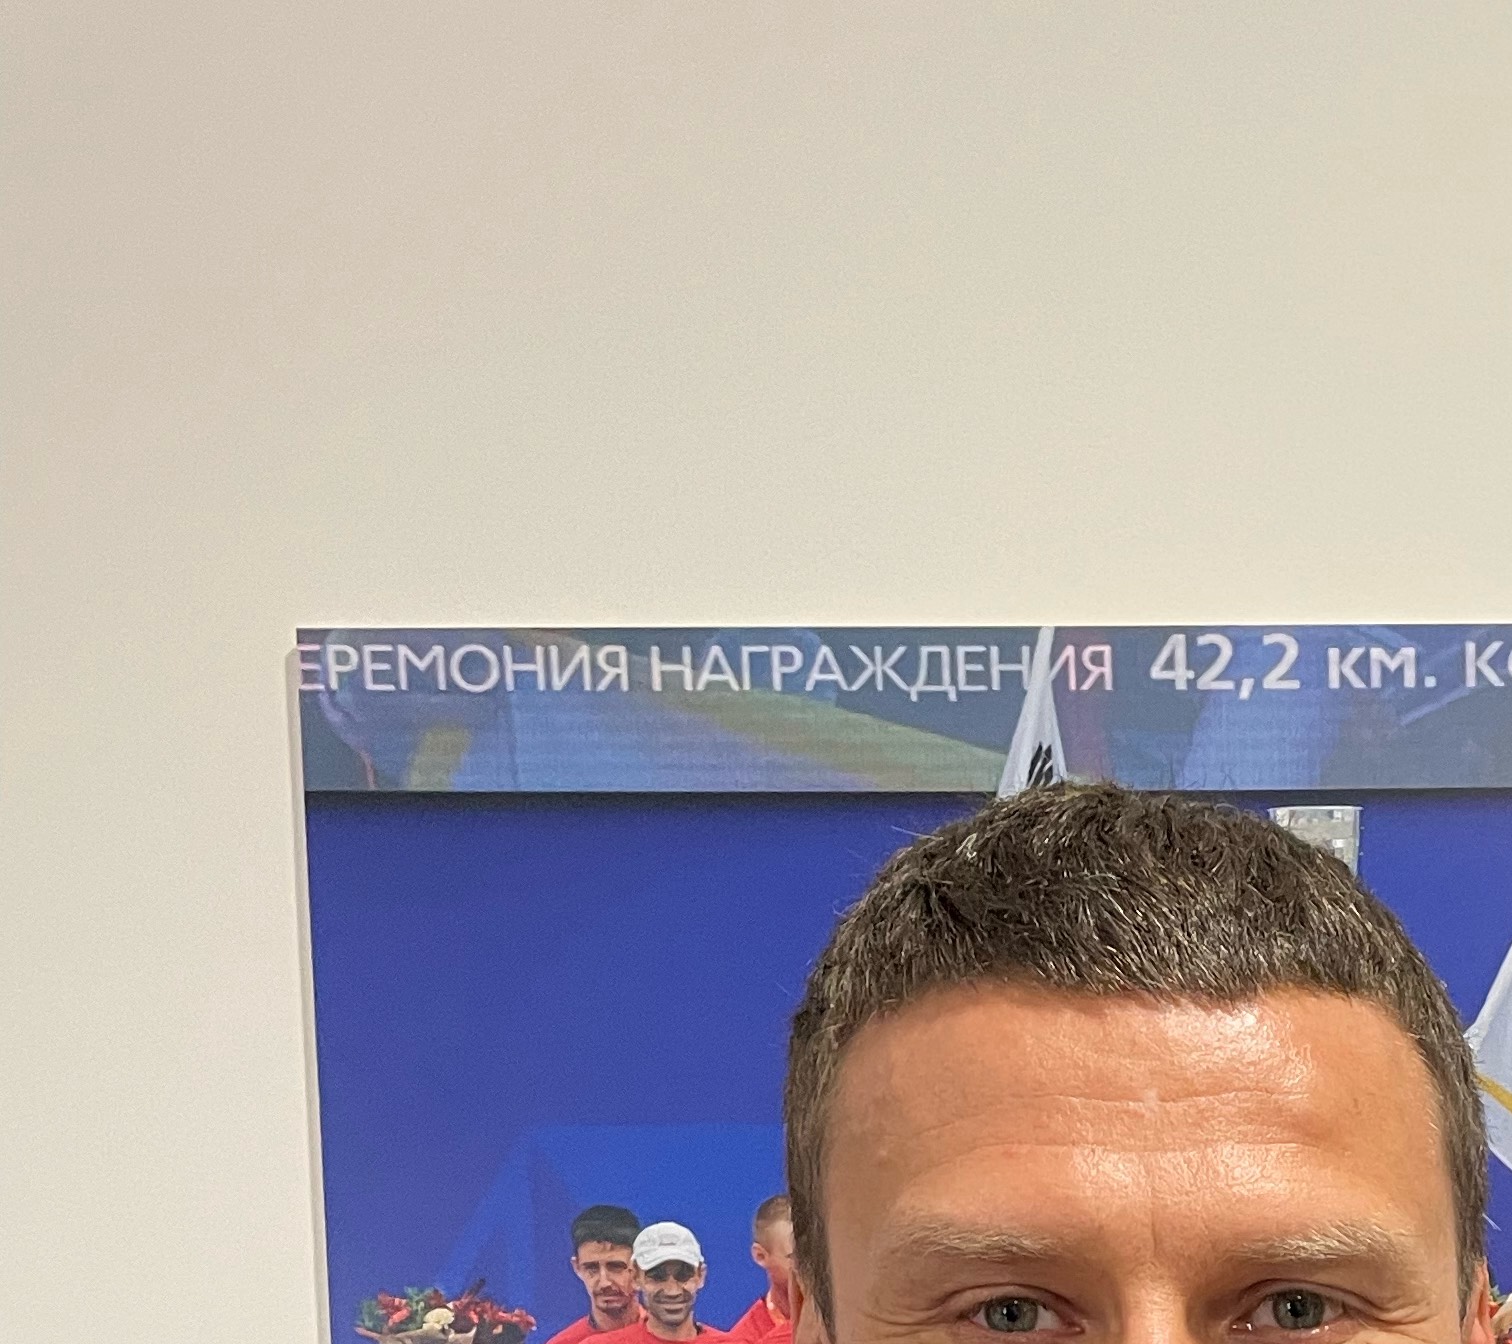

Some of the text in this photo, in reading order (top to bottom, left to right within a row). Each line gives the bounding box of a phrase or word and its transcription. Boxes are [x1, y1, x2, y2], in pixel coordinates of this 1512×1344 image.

[297, 643, 630, 692] ЕРЕМОНИЯ
[651, 643, 1113, 702] НАГРАЖДЕНИЯ
[1149, 633, 1300, 700] 42,2
